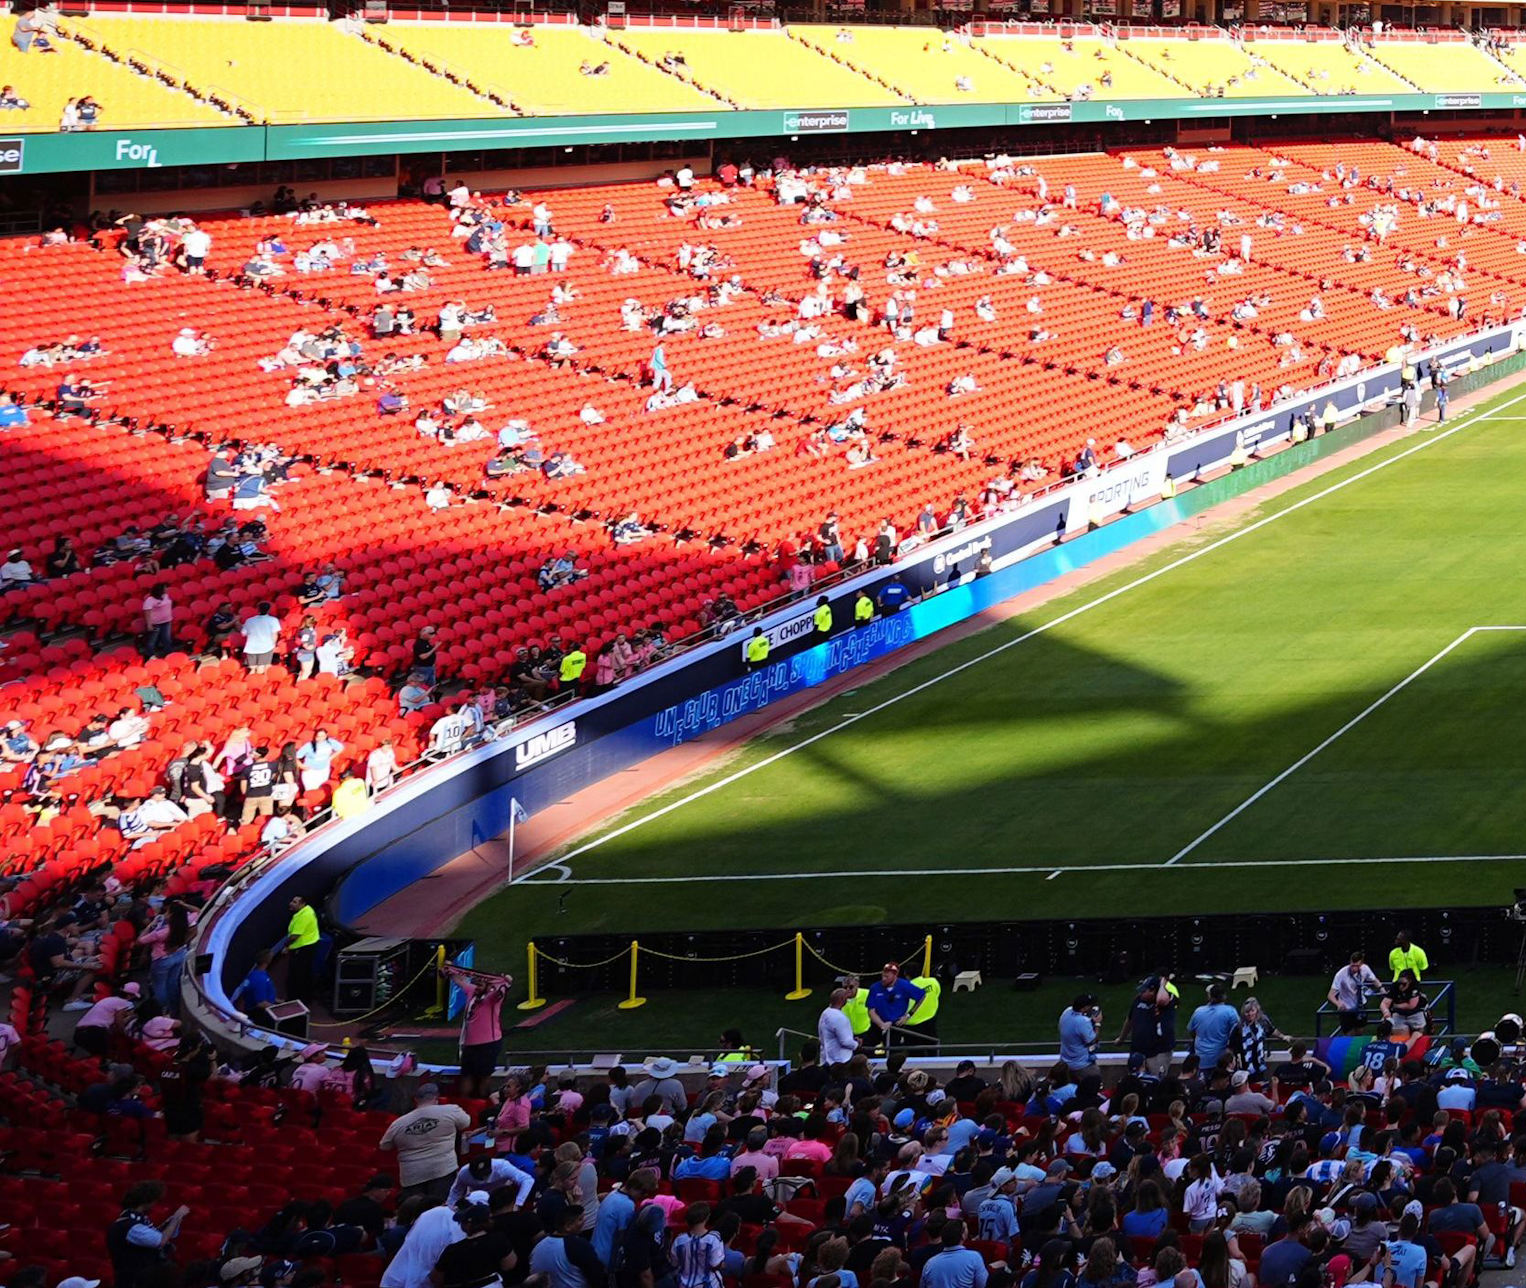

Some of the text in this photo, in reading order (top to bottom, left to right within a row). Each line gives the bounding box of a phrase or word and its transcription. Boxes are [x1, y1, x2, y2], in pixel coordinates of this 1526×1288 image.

[787, 114, 848, 129] enterprise
[891, 112, 909, 125] For
[116, 139, 150, 162] For
[447, 726, 460, 738] 10
[516, 721, 577, 766] UMB
[1365, 1051, 1385, 1070] 18
